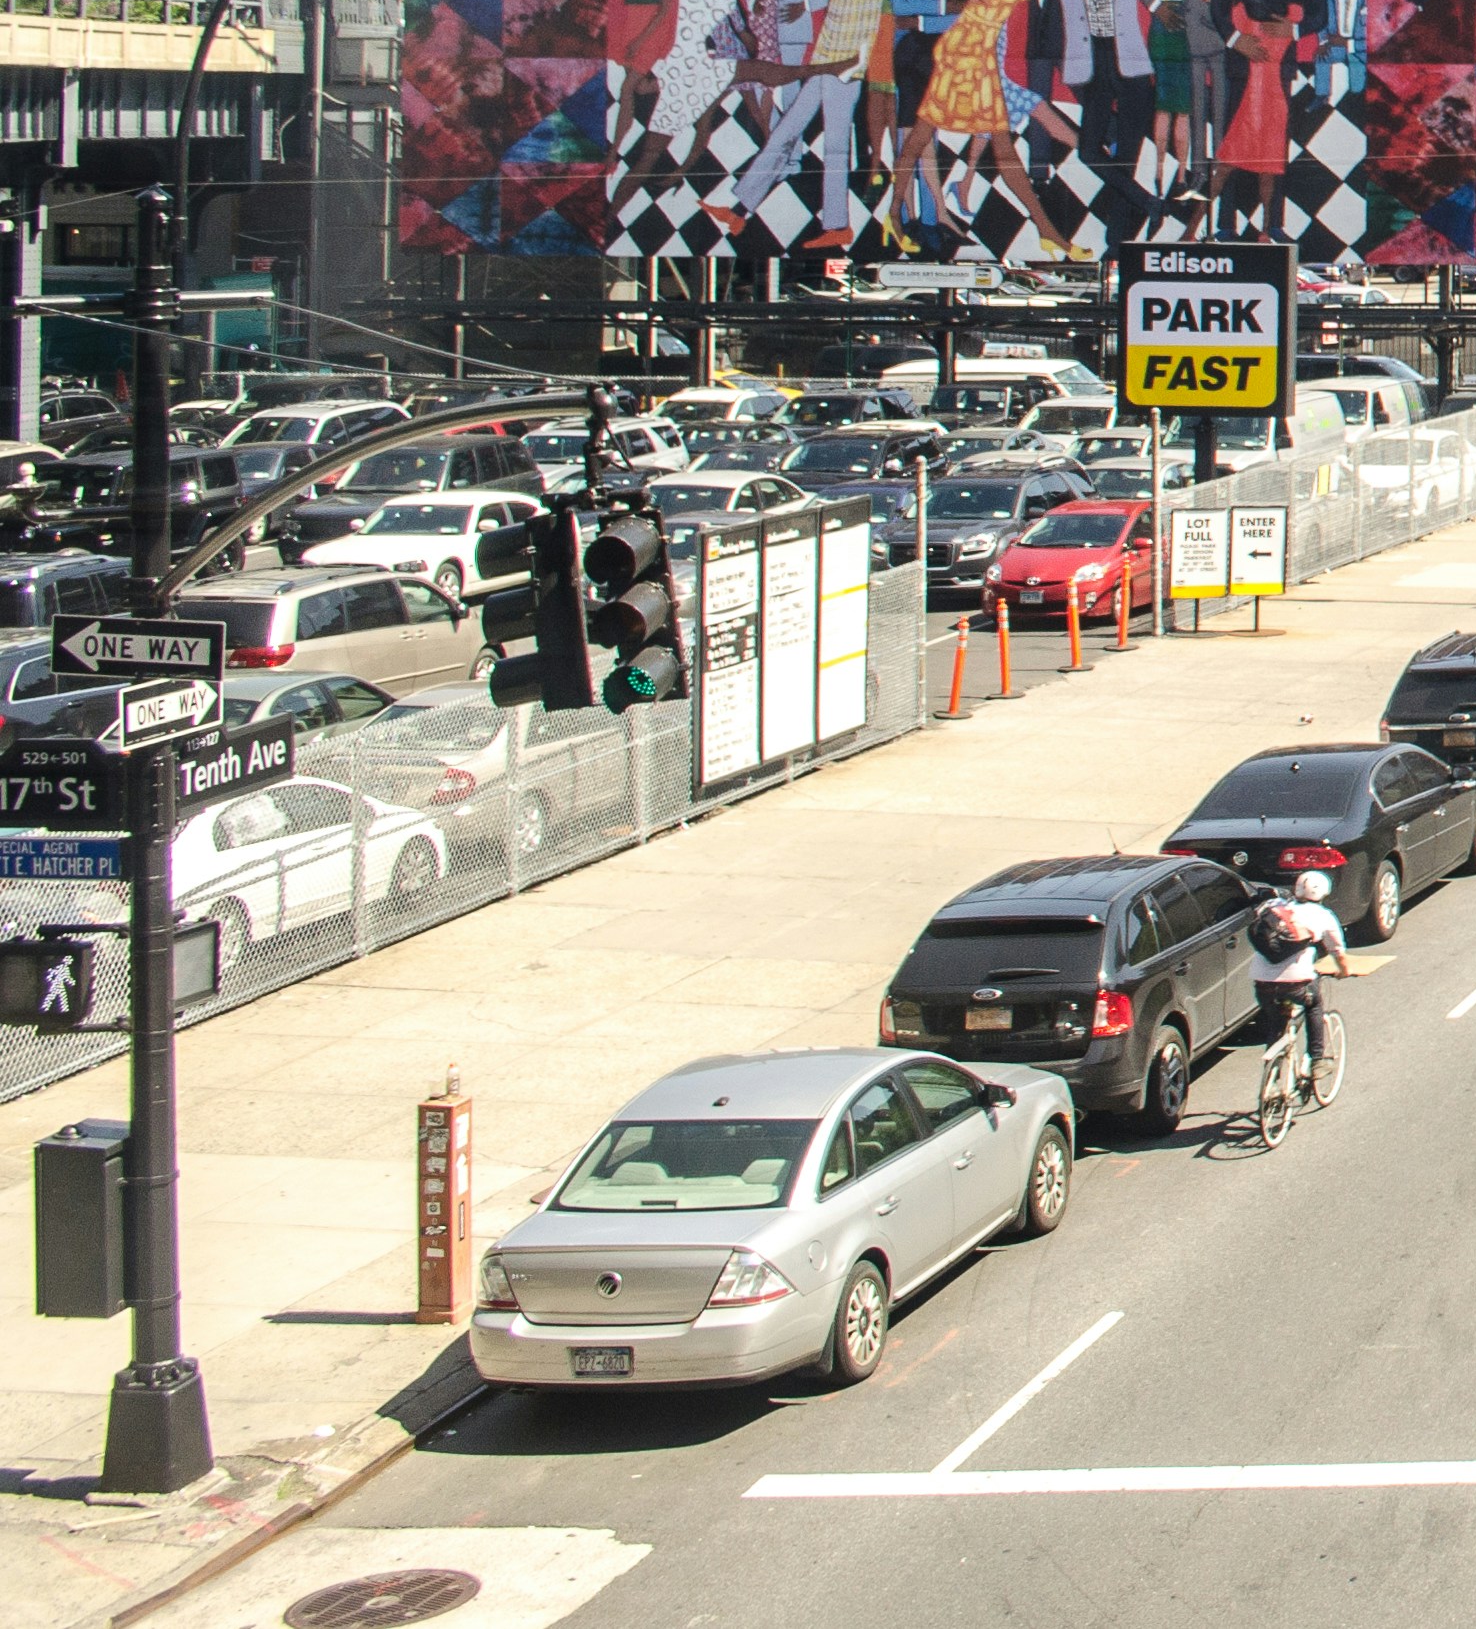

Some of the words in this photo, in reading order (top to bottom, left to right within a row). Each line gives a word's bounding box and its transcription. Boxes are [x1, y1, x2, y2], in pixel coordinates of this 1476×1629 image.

[1143, 251, 1234, 274] Edison
[1141, 297, 1264, 334] PARK
[1142, 354, 1263, 392] FAST
[1187, 518, 1211, 529] LOT
[1239, 517, 1276, 527] ENTER
[1184, 530, 1213, 542] FULL
[1242, 528, 1273, 538] HERE
[83, 635, 134, 659] ONE
[148, 638, 200, 662] WAY
[136, 699, 166, 726] ONE
[178, 688, 207, 715] WAY
[22, 752, 49, 765] 529
[62, 752, 87, 765] 501
[180, 746, 241, 796] Tenth
[247, 739, 287, 775] Ave
[58, 777, 96, 811] St
[42, 841, 80, 854] AGENT
[15, 856, 29, 875] E.
[33, 857, 93, 876] HATCHER
